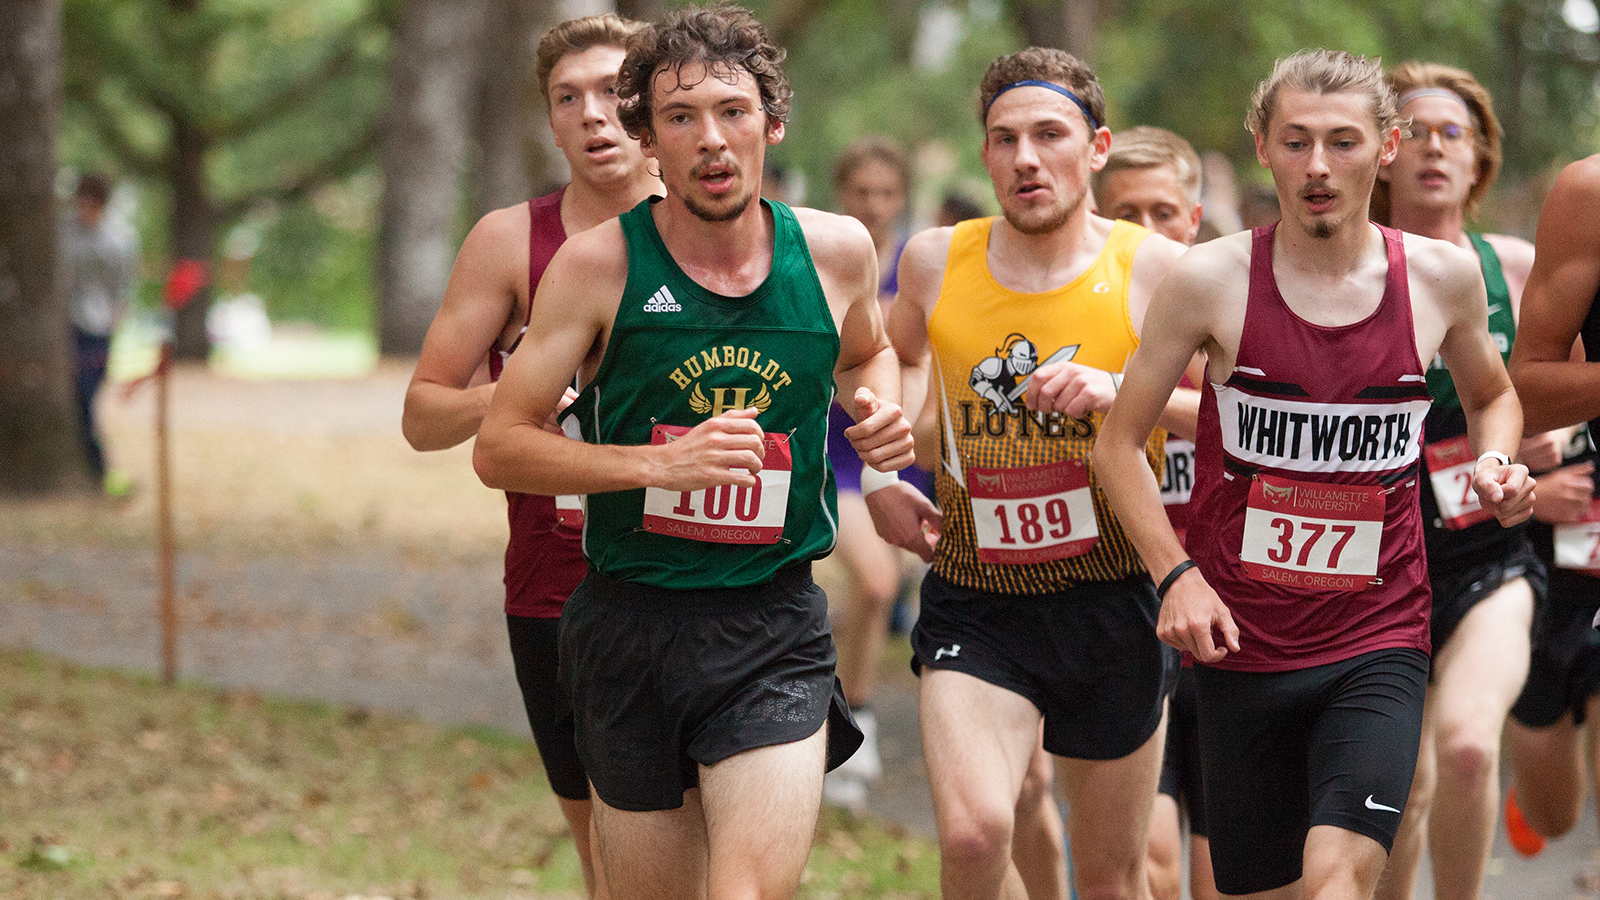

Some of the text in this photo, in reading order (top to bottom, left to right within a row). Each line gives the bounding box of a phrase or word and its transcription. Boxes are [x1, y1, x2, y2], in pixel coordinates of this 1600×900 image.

[643, 302, 682, 312] adidas
[669, 346, 792, 391] HUMBOLDT
[961, 403, 1094, 438] LUTES
[1237, 401, 1411, 462] WHITWORTH
[1298, 500, 1361, 512] UNIVERSITY
[1299, 488, 1369, 503] WILLAMETTE
[666, 522, 762, 541] SALEM, OREGON
[994, 499, 1072, 544] 189
[1267, 517, 1356, 569] 377
[1261, 568, 1354, 588] SALEM, OREGON
